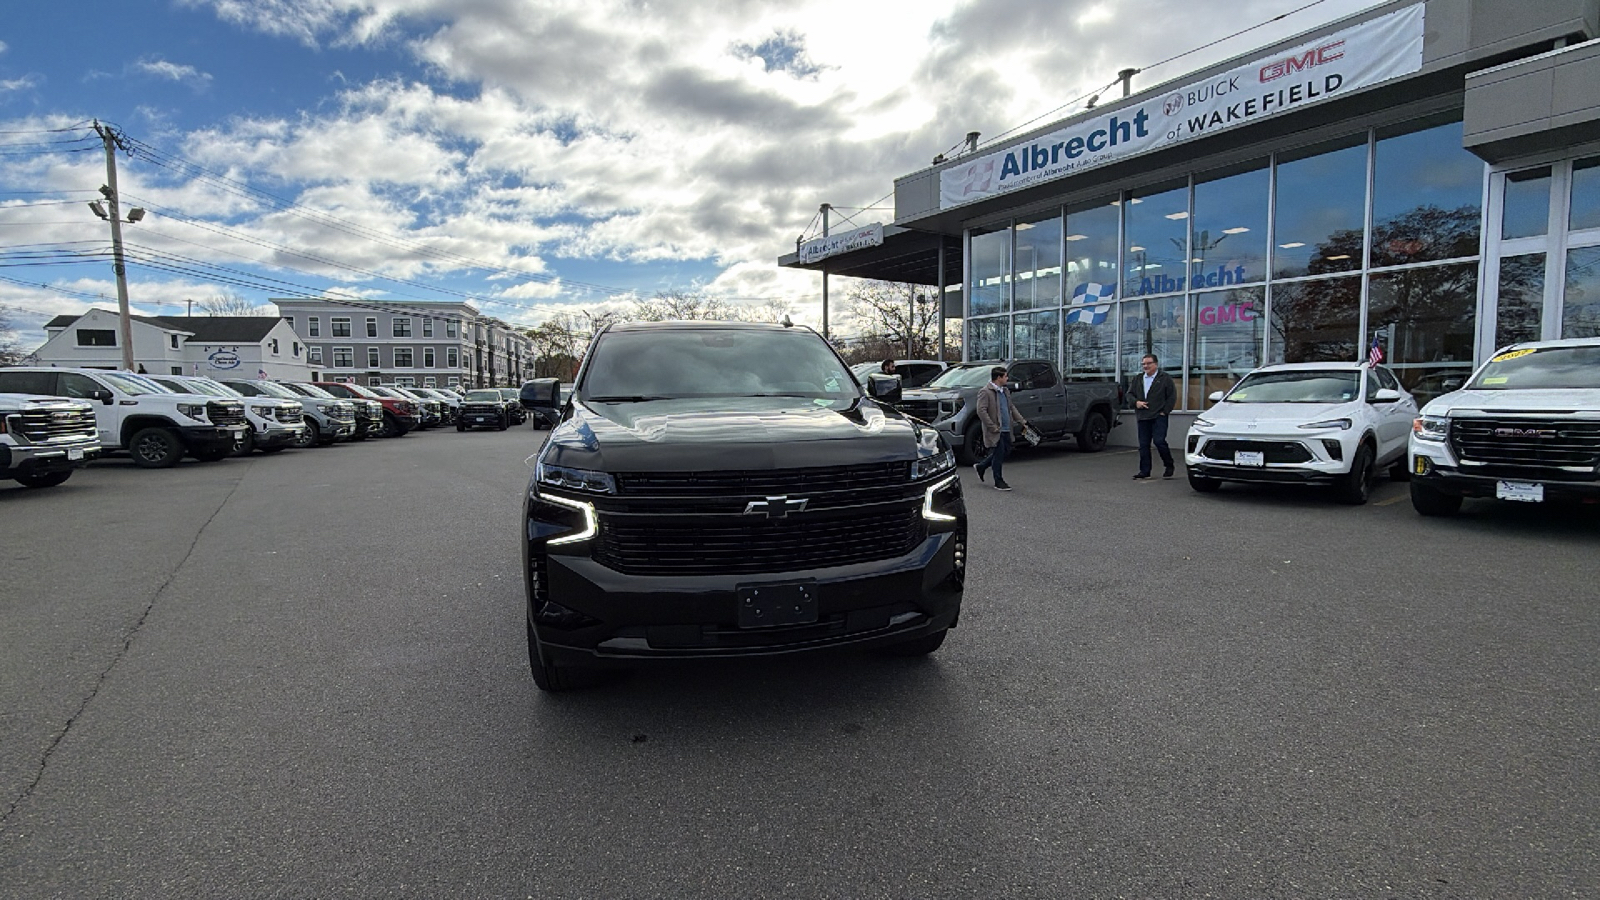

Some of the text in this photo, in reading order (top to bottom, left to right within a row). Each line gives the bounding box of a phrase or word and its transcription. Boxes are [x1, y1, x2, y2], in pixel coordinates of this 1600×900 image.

[1188, 39, 1346, 106] BUICK GMC
[1166, 73, 1343, 140] of WAKEFIELD
[1000, 107, 1149, 181] Albrecht
[1043, 162, 1075, 177] Albrecht
[1092, 151, 1113, 165] Group
[1138, 265, 1246, 296] Albrecht
[1199, 301, 1254, 326] GMC
[1494, 428, 1556, 439] GMC
